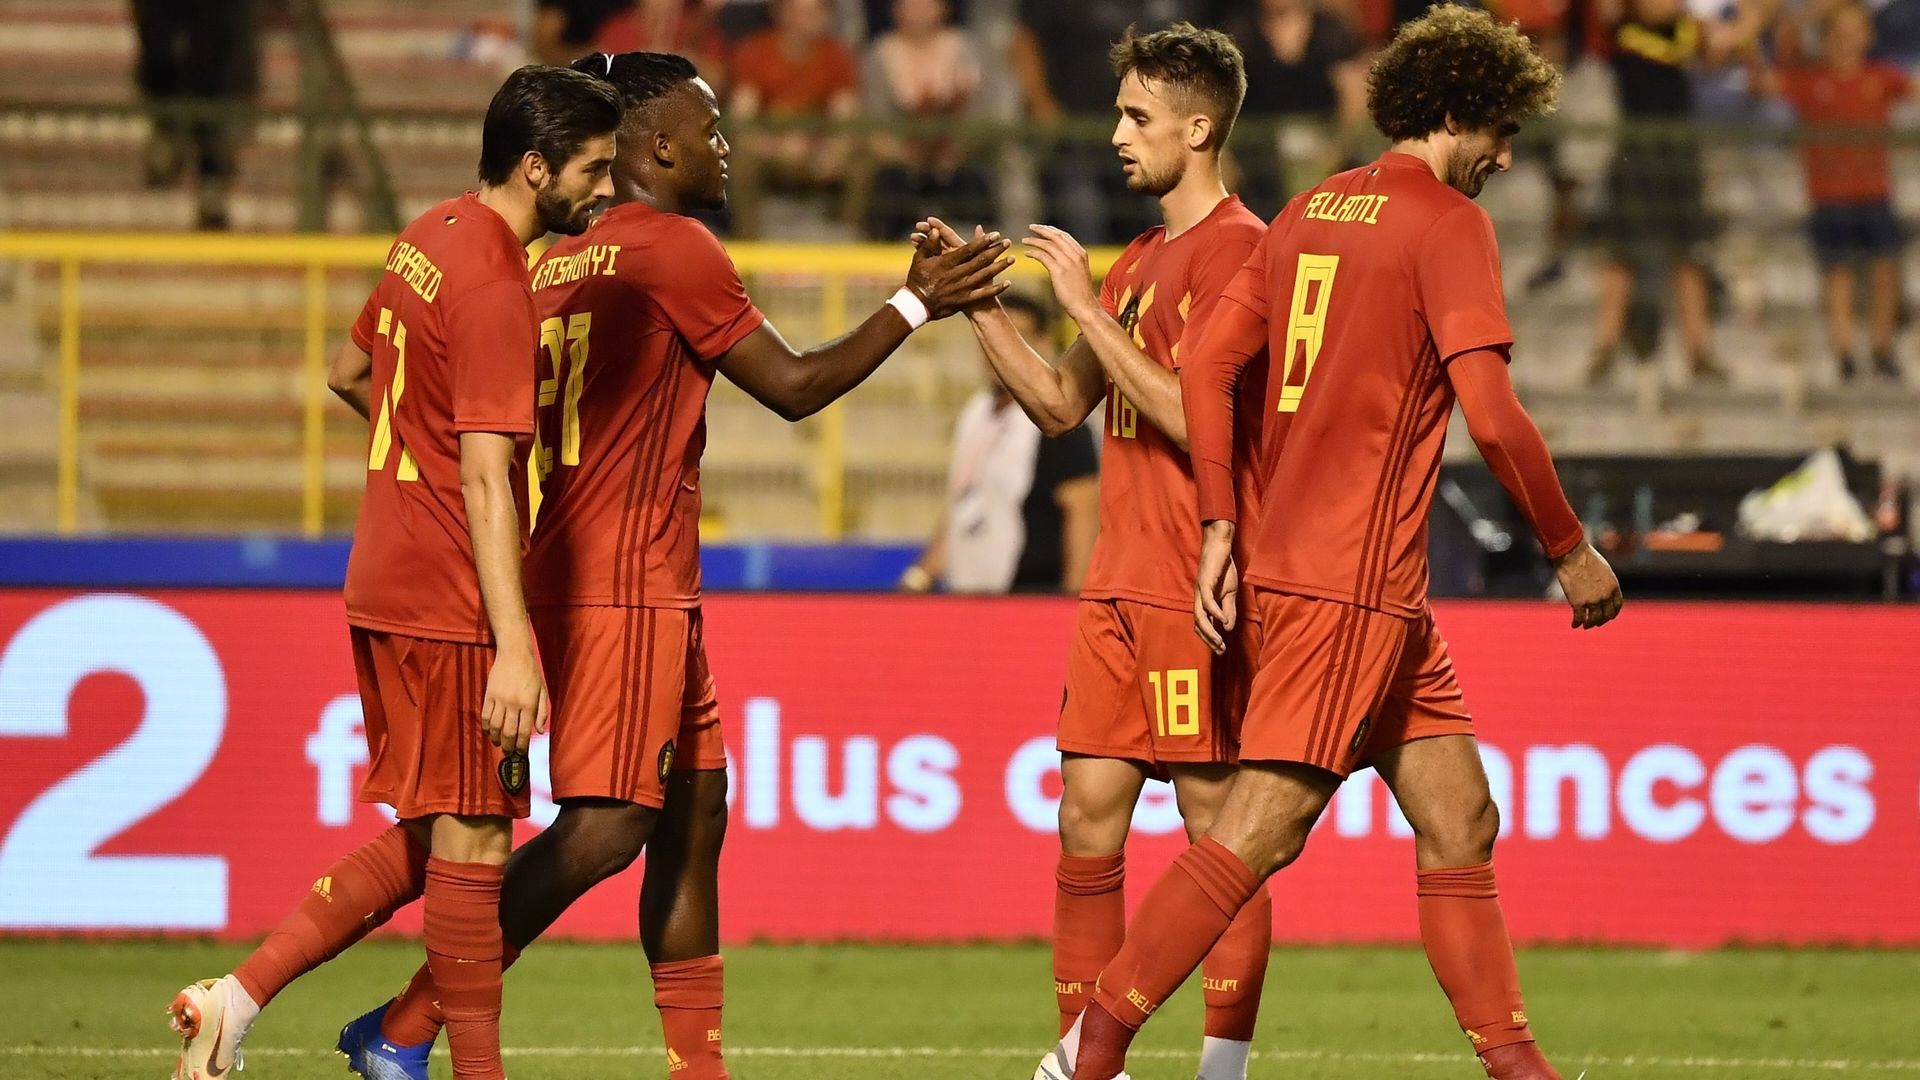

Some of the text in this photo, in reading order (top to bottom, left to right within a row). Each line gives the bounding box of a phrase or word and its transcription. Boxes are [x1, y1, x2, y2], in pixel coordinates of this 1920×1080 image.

[1277, 253, 1339, 412] 8
[0, 592, 228, 928] 2
[1148, 668, 1199, 736] 18
